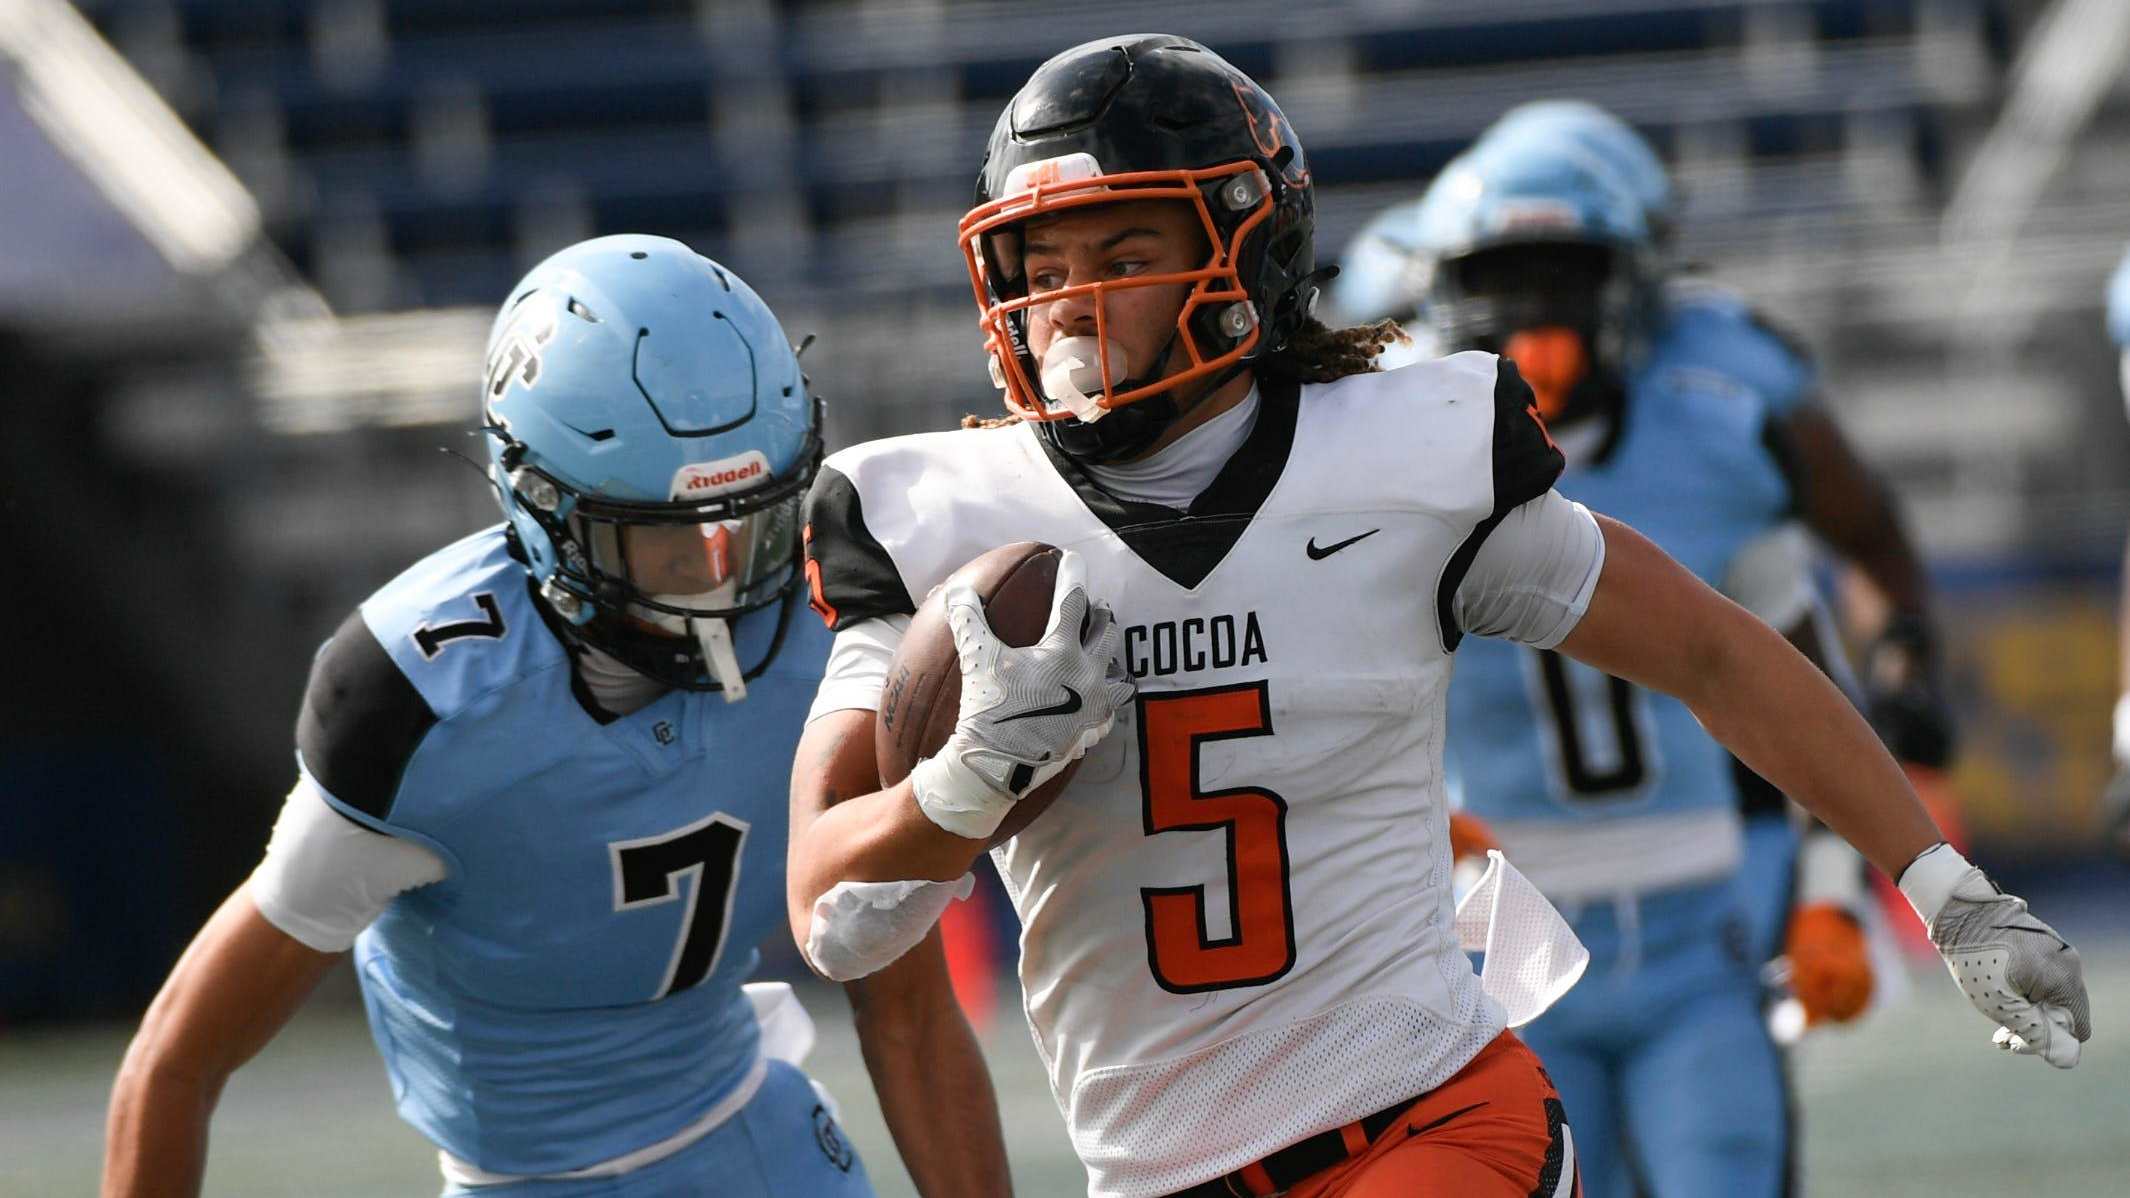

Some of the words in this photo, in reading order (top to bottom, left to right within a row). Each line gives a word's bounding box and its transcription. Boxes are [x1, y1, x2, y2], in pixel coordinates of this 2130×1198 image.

[685, 461, 762, 490] Riddell
[409, 592, 509, 661] 7
[1124, 610, 1268, 679] COCOA
[1136, 679, 1297, 996] 5
[608, 811, 750, 1001] 7
